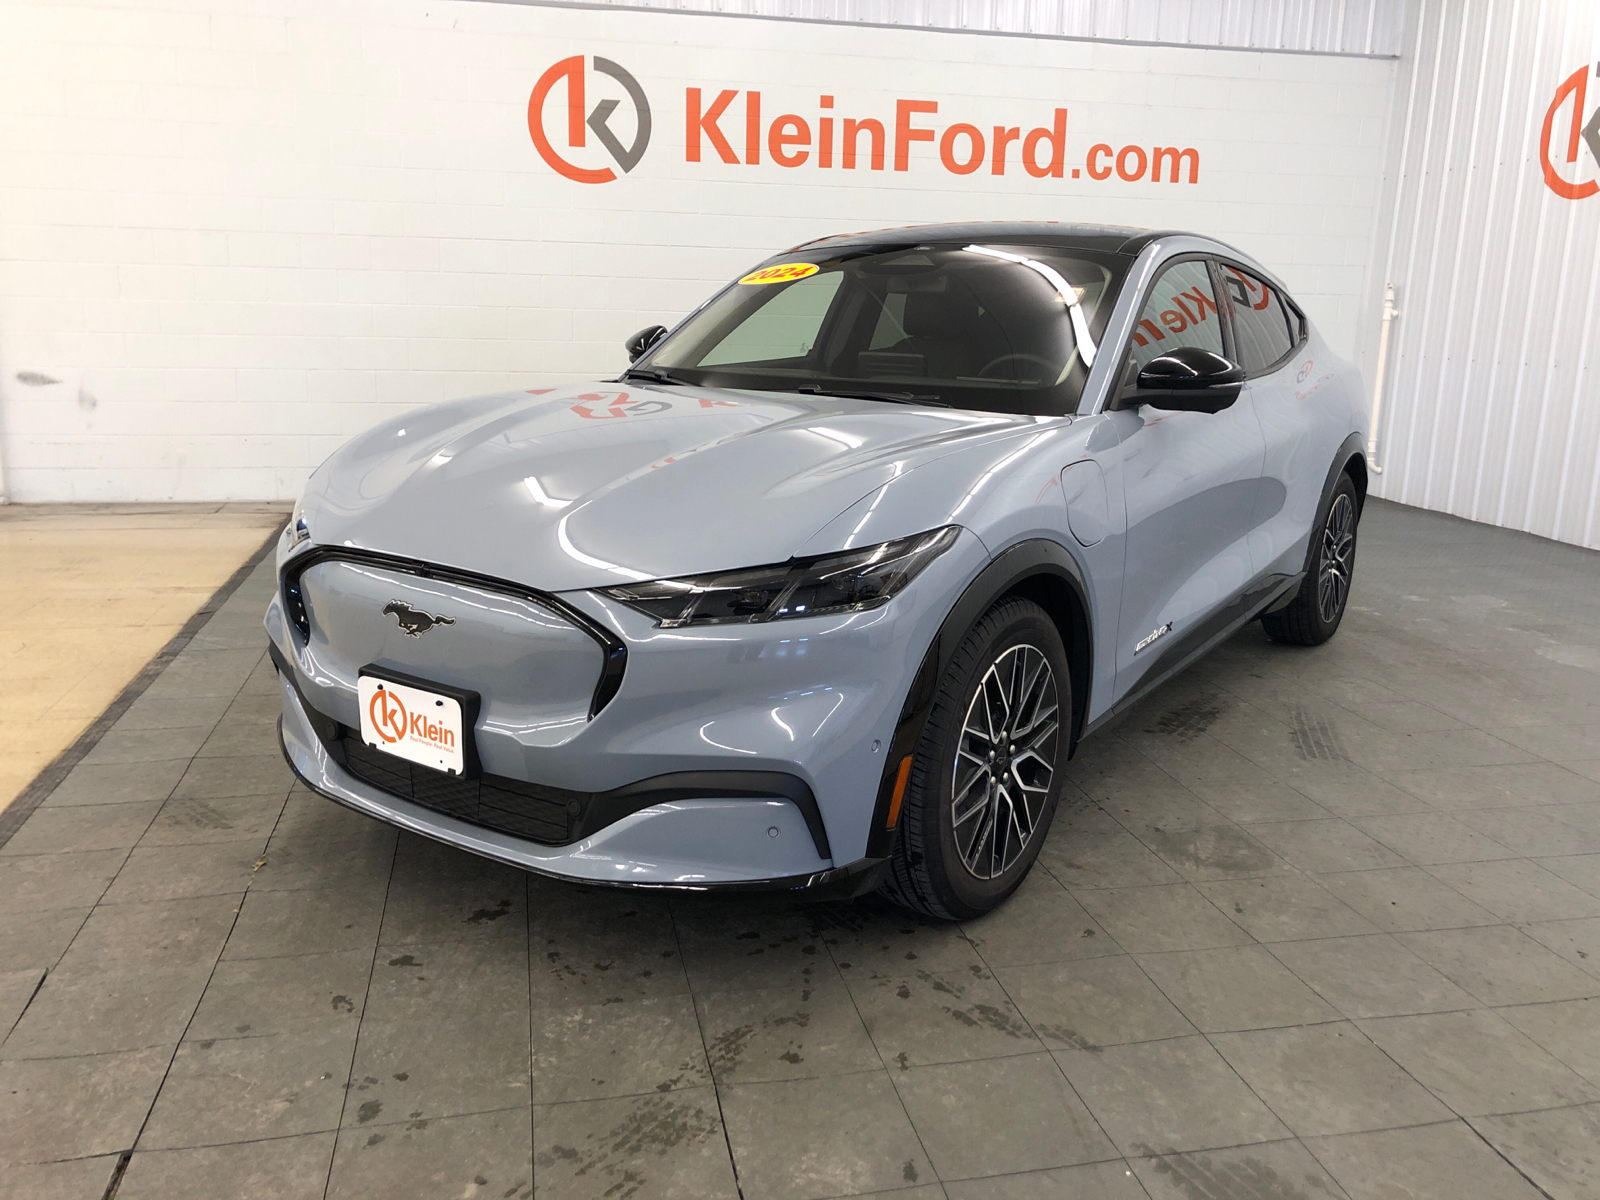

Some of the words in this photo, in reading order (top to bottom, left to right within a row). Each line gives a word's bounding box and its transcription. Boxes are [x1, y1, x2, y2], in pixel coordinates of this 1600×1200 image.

[685, 87, 1200, 185] KleinFord.com
[744, 266, 814, 282] 2024
[410, 711, 454, 748] Klein
